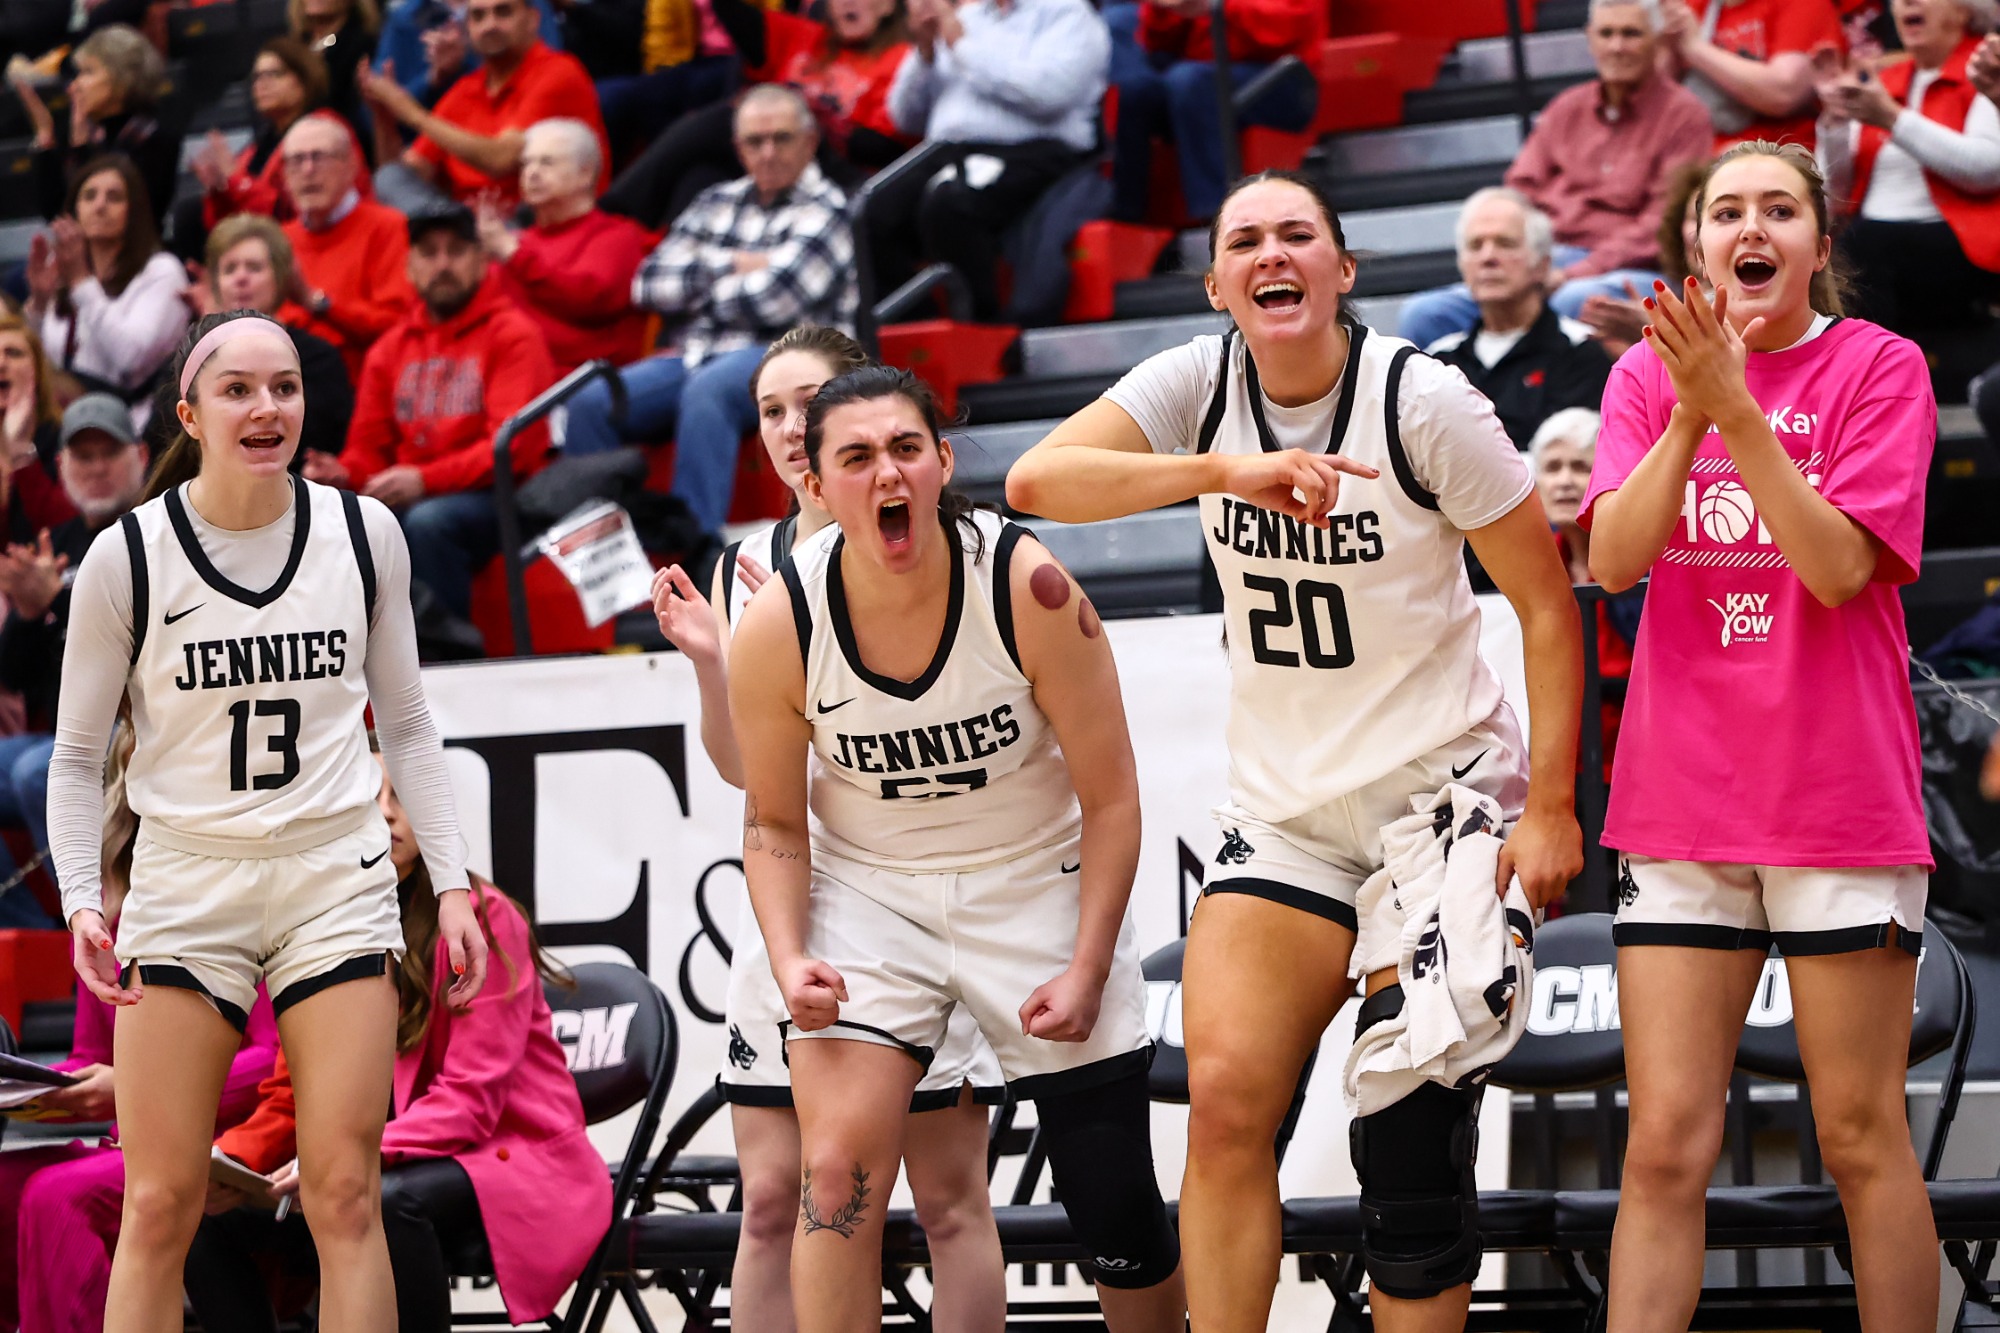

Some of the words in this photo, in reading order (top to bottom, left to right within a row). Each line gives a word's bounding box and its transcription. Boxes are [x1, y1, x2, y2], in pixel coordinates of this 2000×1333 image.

[1213, 497, 1385, 566] JENNIES
[1243, 572, 1355, 669] 20
[1726, 593, 1770, 613] KAY
[175, 629, 347, 691] JENNIES
[1754, 635, 1768, 643] fund
[228, 698, 301, 791] 13
[832, 703, 1021, 774] JENNIES
